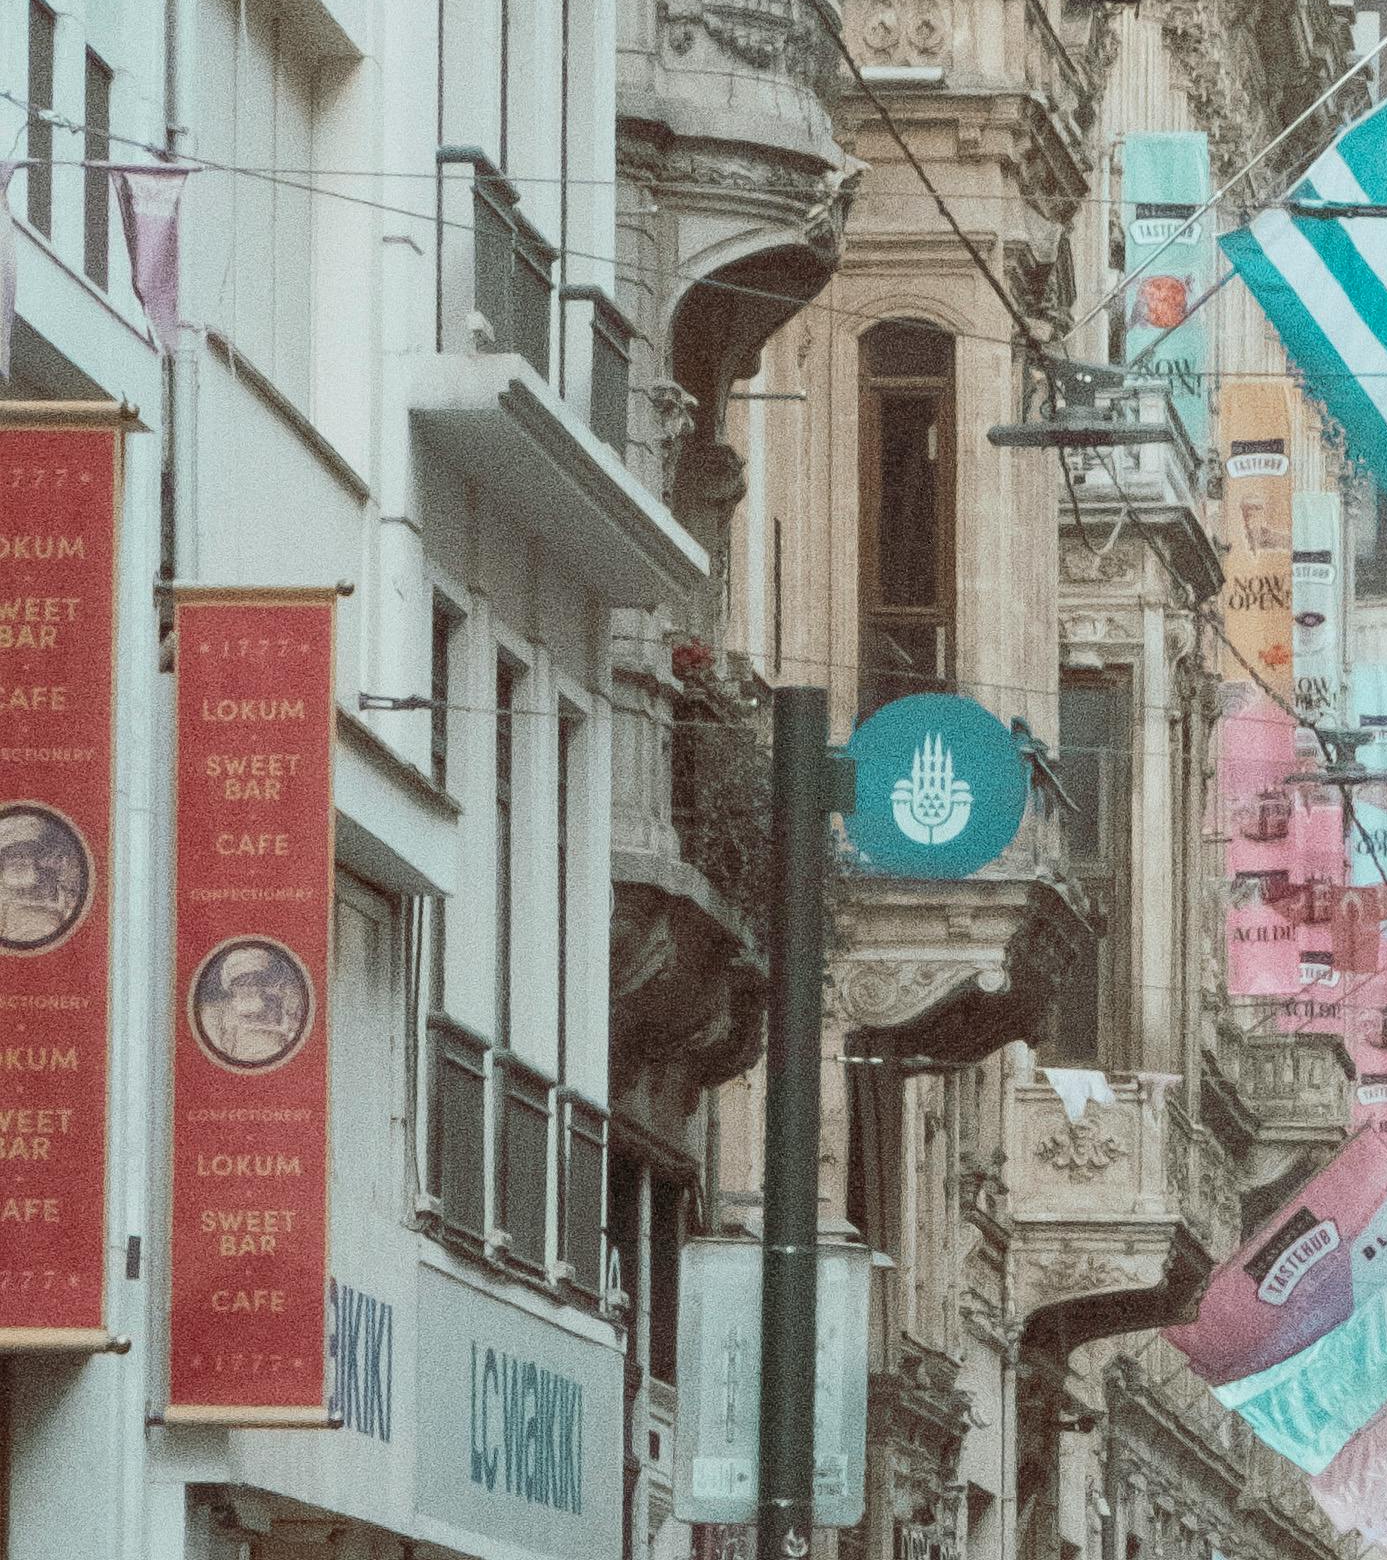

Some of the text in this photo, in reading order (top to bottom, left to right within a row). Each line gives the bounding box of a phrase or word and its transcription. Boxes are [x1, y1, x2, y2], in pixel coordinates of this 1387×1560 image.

[1234, 575, 1286, 593] NOW
[1228, 590, 1291, 611] OPEN!
[202, 699, 305, 721] LOKUM
[206, 754, 301, 776] SWEET
[225, 778, 281, 800] BAR
[215, 834, 289, 856] CAFE
[198, 1154, 302, 1176] LOKUM
[201, 1210, 297, 1232] SWEET
[219, 1235, 276, 1256] BAR
[1266, 1227, 1331, 1295] TASTEHUB
[212, 1290, 286, 1312] CAFE
